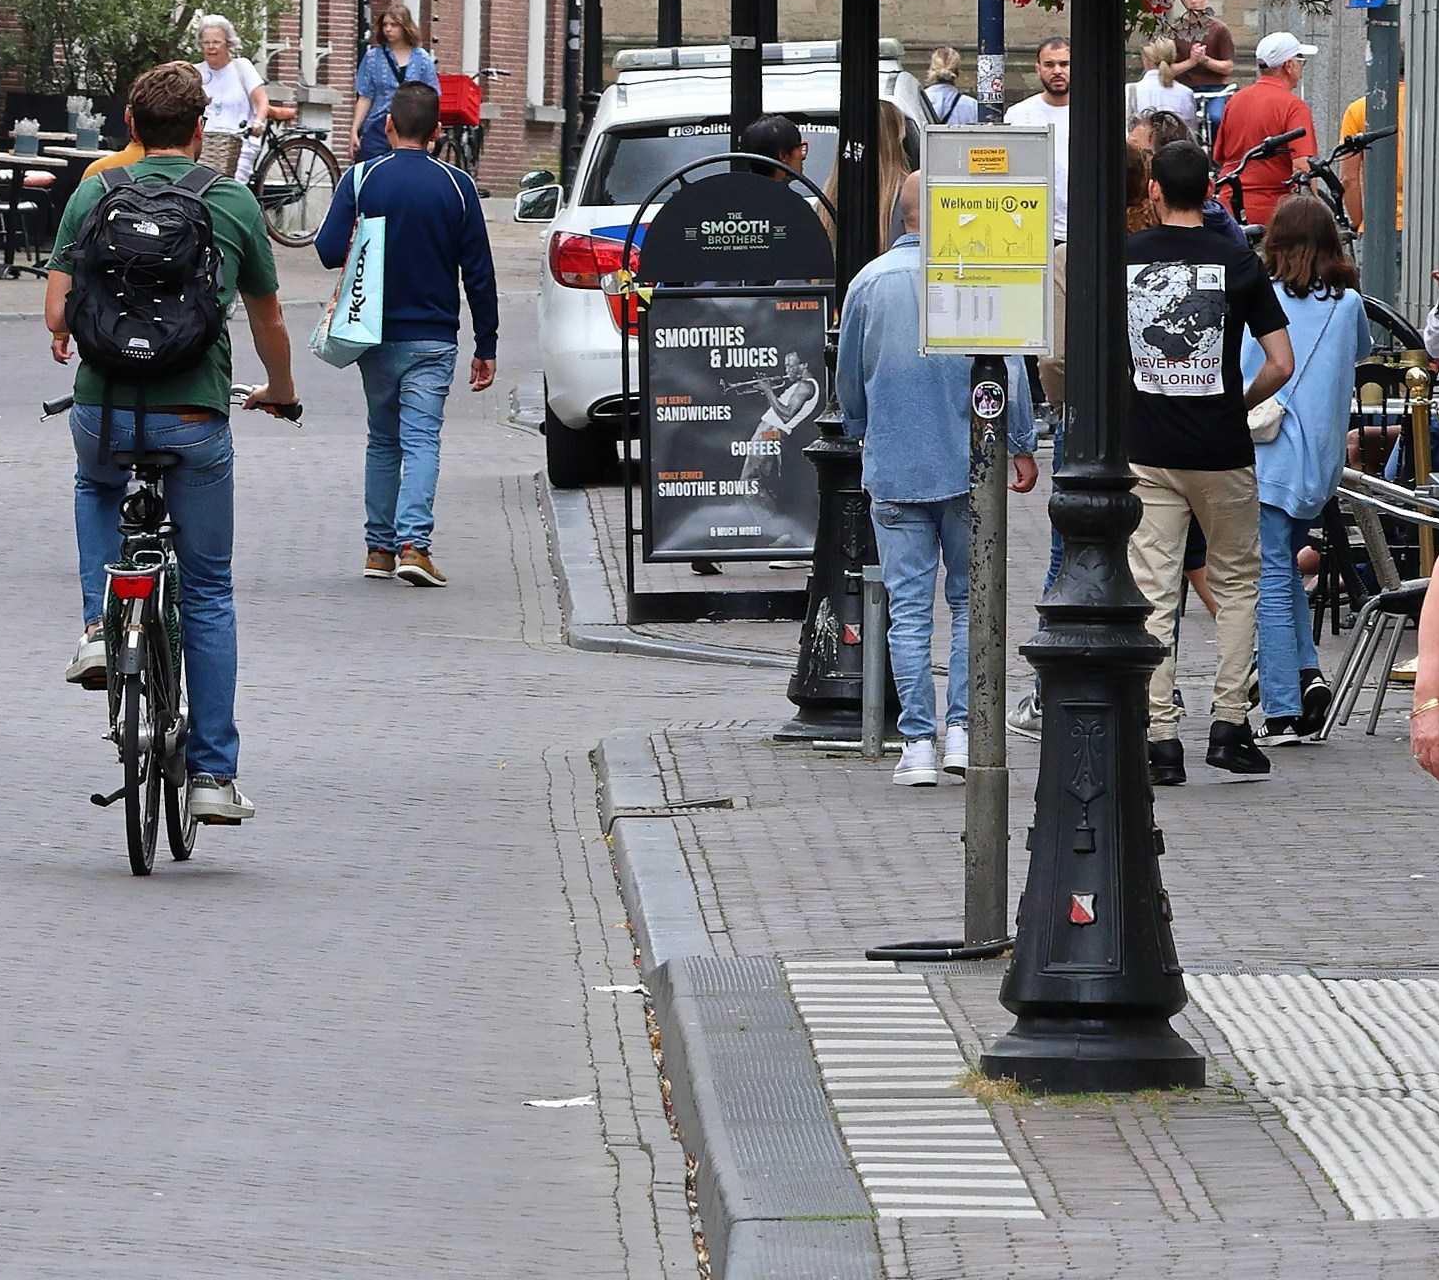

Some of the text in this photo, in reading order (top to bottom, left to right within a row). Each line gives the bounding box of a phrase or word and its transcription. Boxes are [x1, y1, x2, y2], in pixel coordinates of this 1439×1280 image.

[940, 197, 983, 210] Welkom
[986, 196, 999, 212] bij
[727, 212, 743, 220] THE
[700, 220, 770, 234] SMOOTH
[707, 234, 764, 245] BROTHERS
[937, 272, 943, 281] 2
[655, 326, 745, 348] SMOOTHIES
[710, 347, 778, 368] & JUICES
[1134, 357, 1220, 369] NEVER STOP
[1141, 372, 1216, 385] EXPLORING
[657, 405, 731, 421] SANDWICHES
[731, 441, 781, 456] COFFEES
[658, 480, 759, 497] SMOOTHIE BOWLS
[717, 527, 737, 536] MUCH
